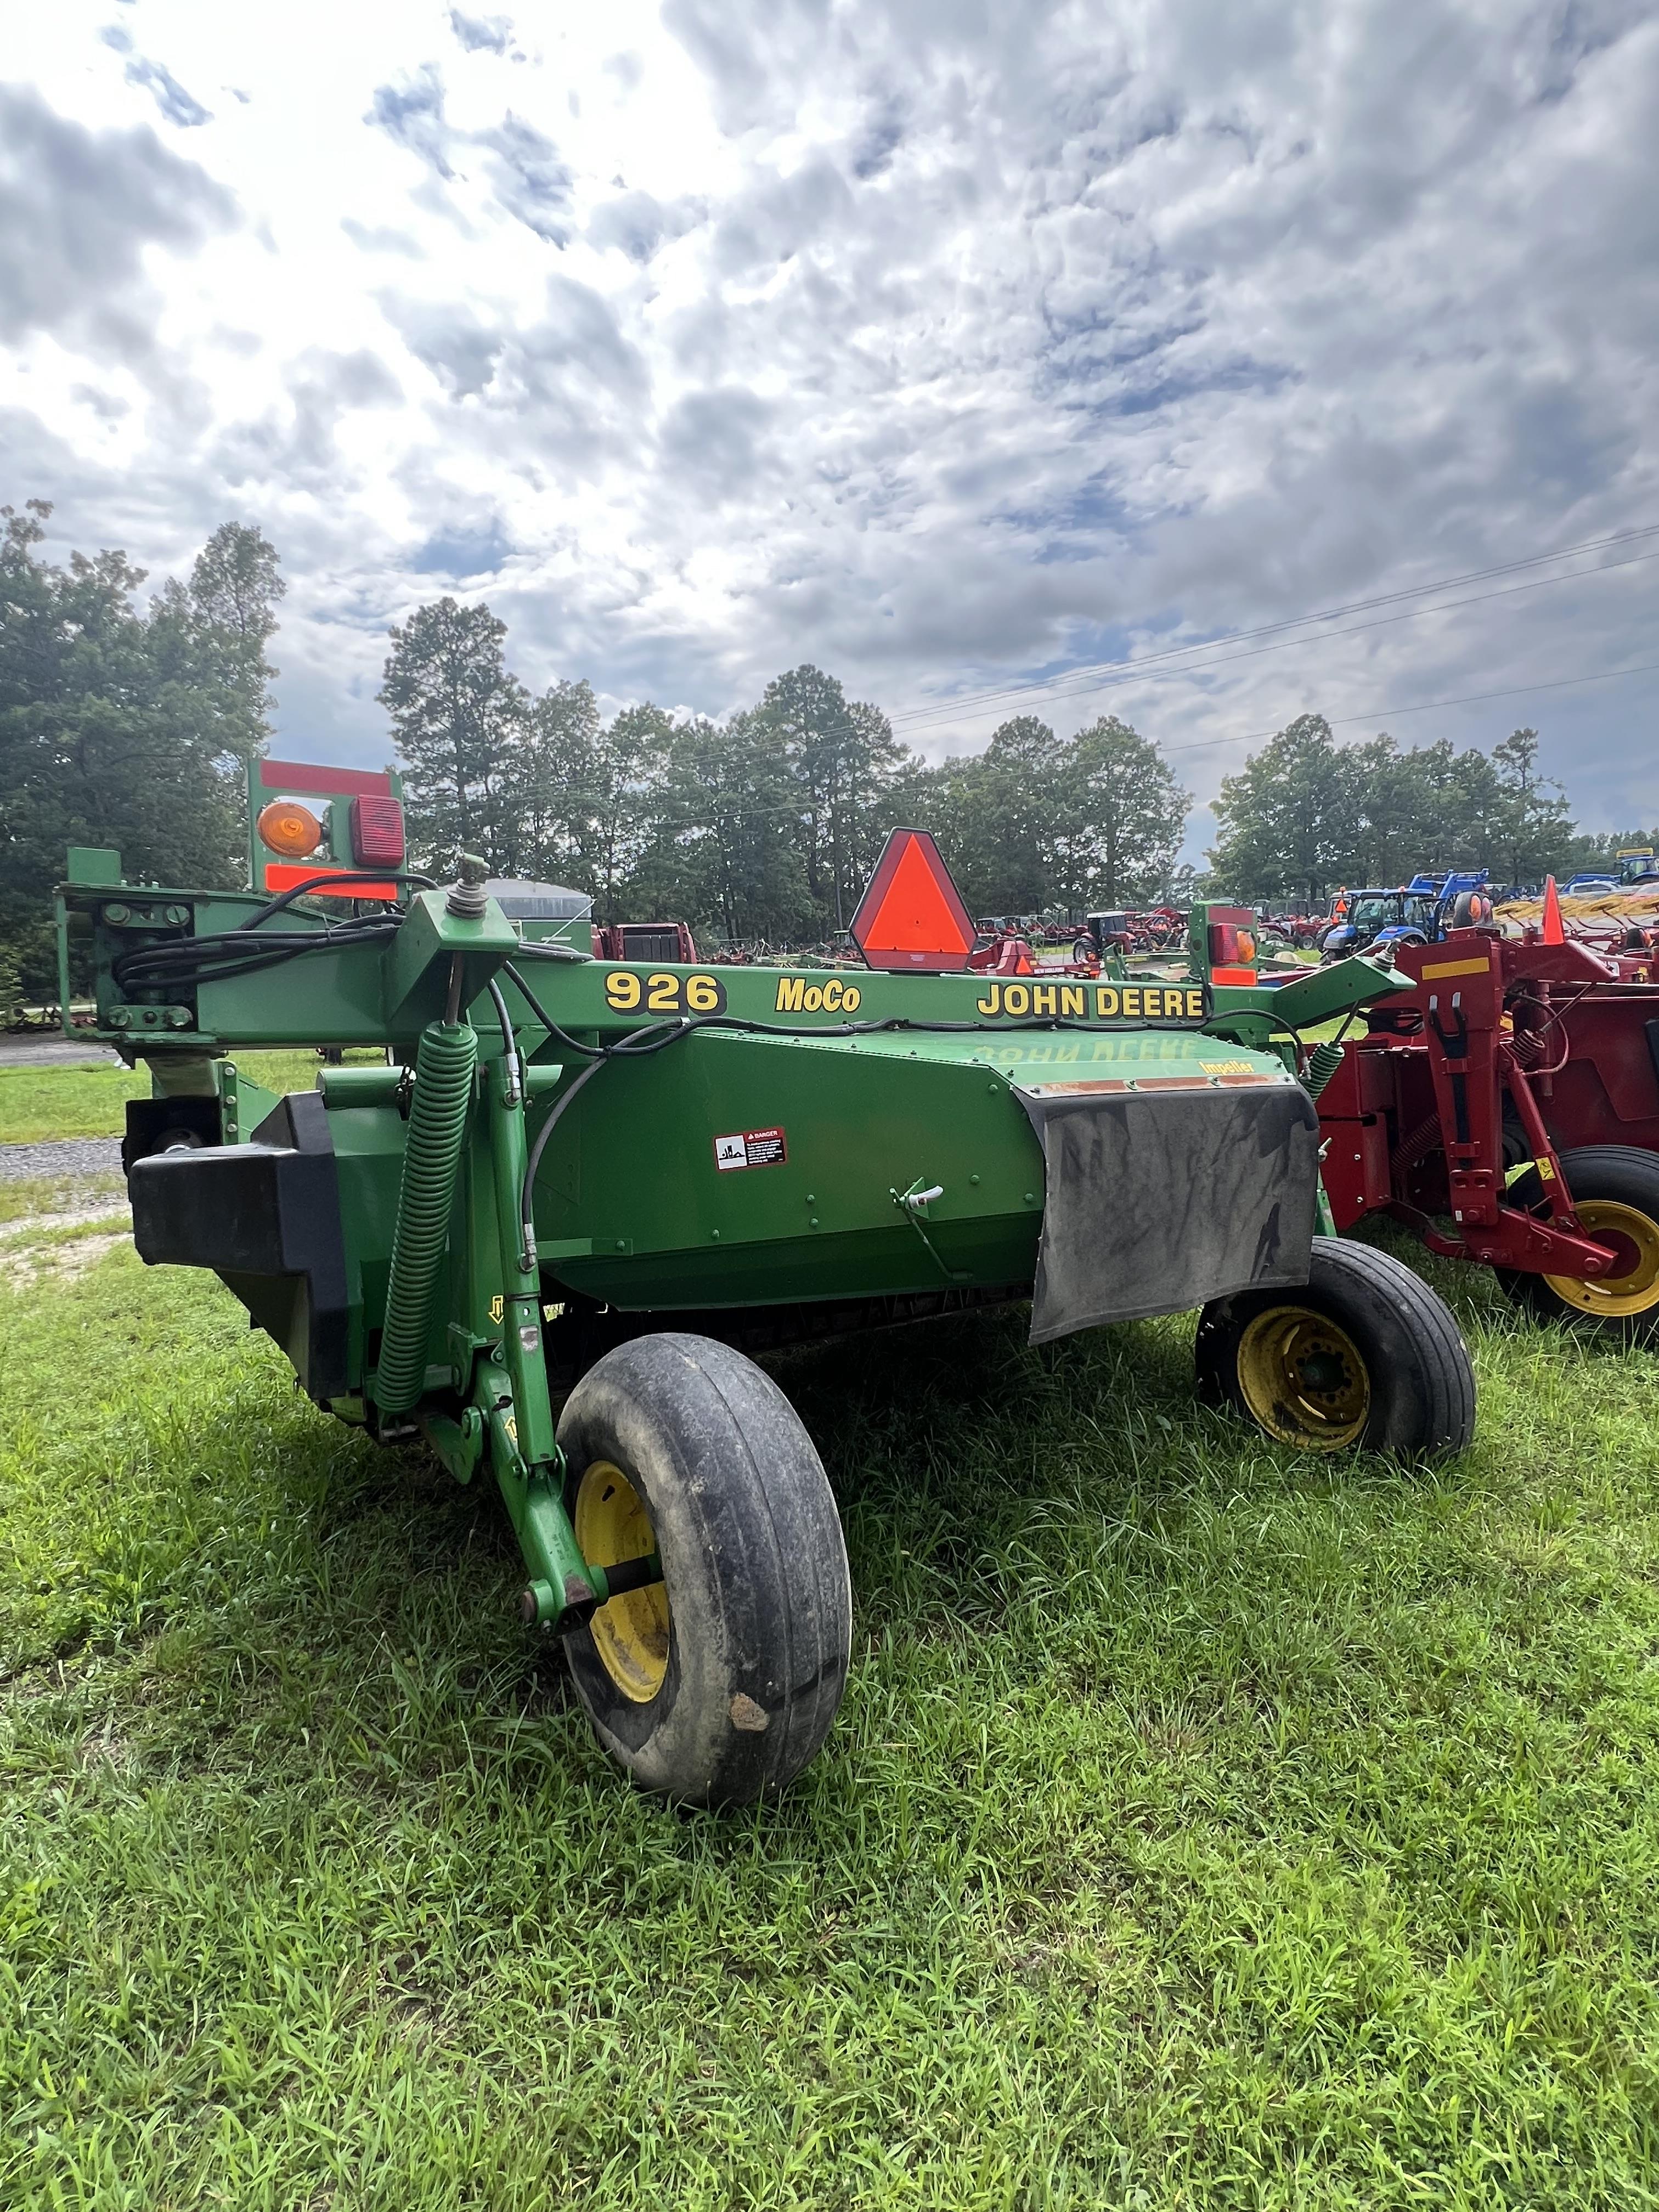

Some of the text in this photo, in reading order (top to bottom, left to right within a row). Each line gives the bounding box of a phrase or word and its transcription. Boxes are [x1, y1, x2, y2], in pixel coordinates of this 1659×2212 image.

[606, 972, 723, 1015] 926
[776, 977, 861, 1013] MoCo
[977, 984, 1205, 1019] JOHN DEERE
[1197, 1060, 1255, 1076] Impeller
[754, 1130, 778, 1139] DANGER
